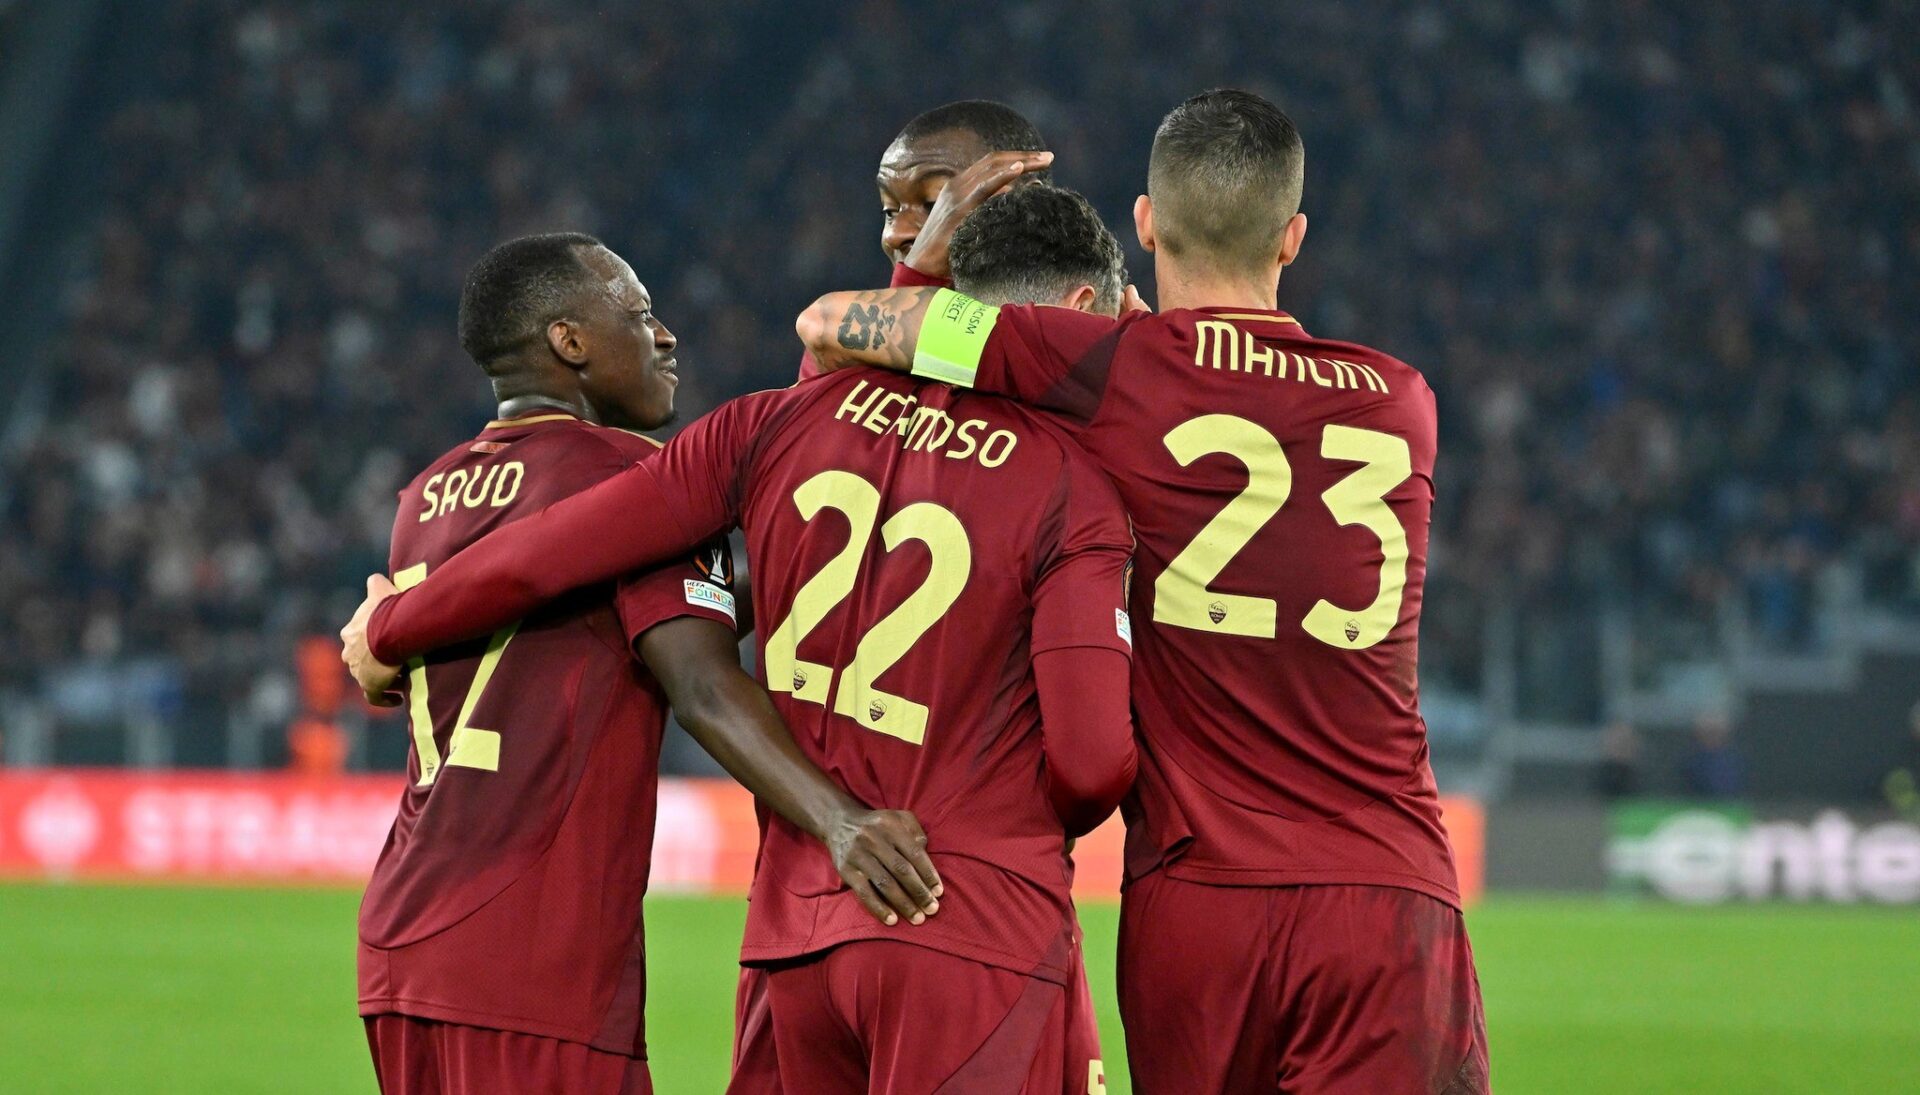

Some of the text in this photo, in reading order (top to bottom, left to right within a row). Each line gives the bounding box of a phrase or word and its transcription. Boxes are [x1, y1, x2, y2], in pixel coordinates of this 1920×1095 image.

[837, 303, 880, 350] 23
[965, 306, 986, 335] ACISM
[1194, 320, 1389, 394] MANCINI
[834, 379, 1017, 468] HERMOSO
[420, 461, 524, 522] SAUD
[1152, 414, 1412, 650] 23
[686, 580, 705, 588] UEFA
[764, 470, 972, 746] 22
